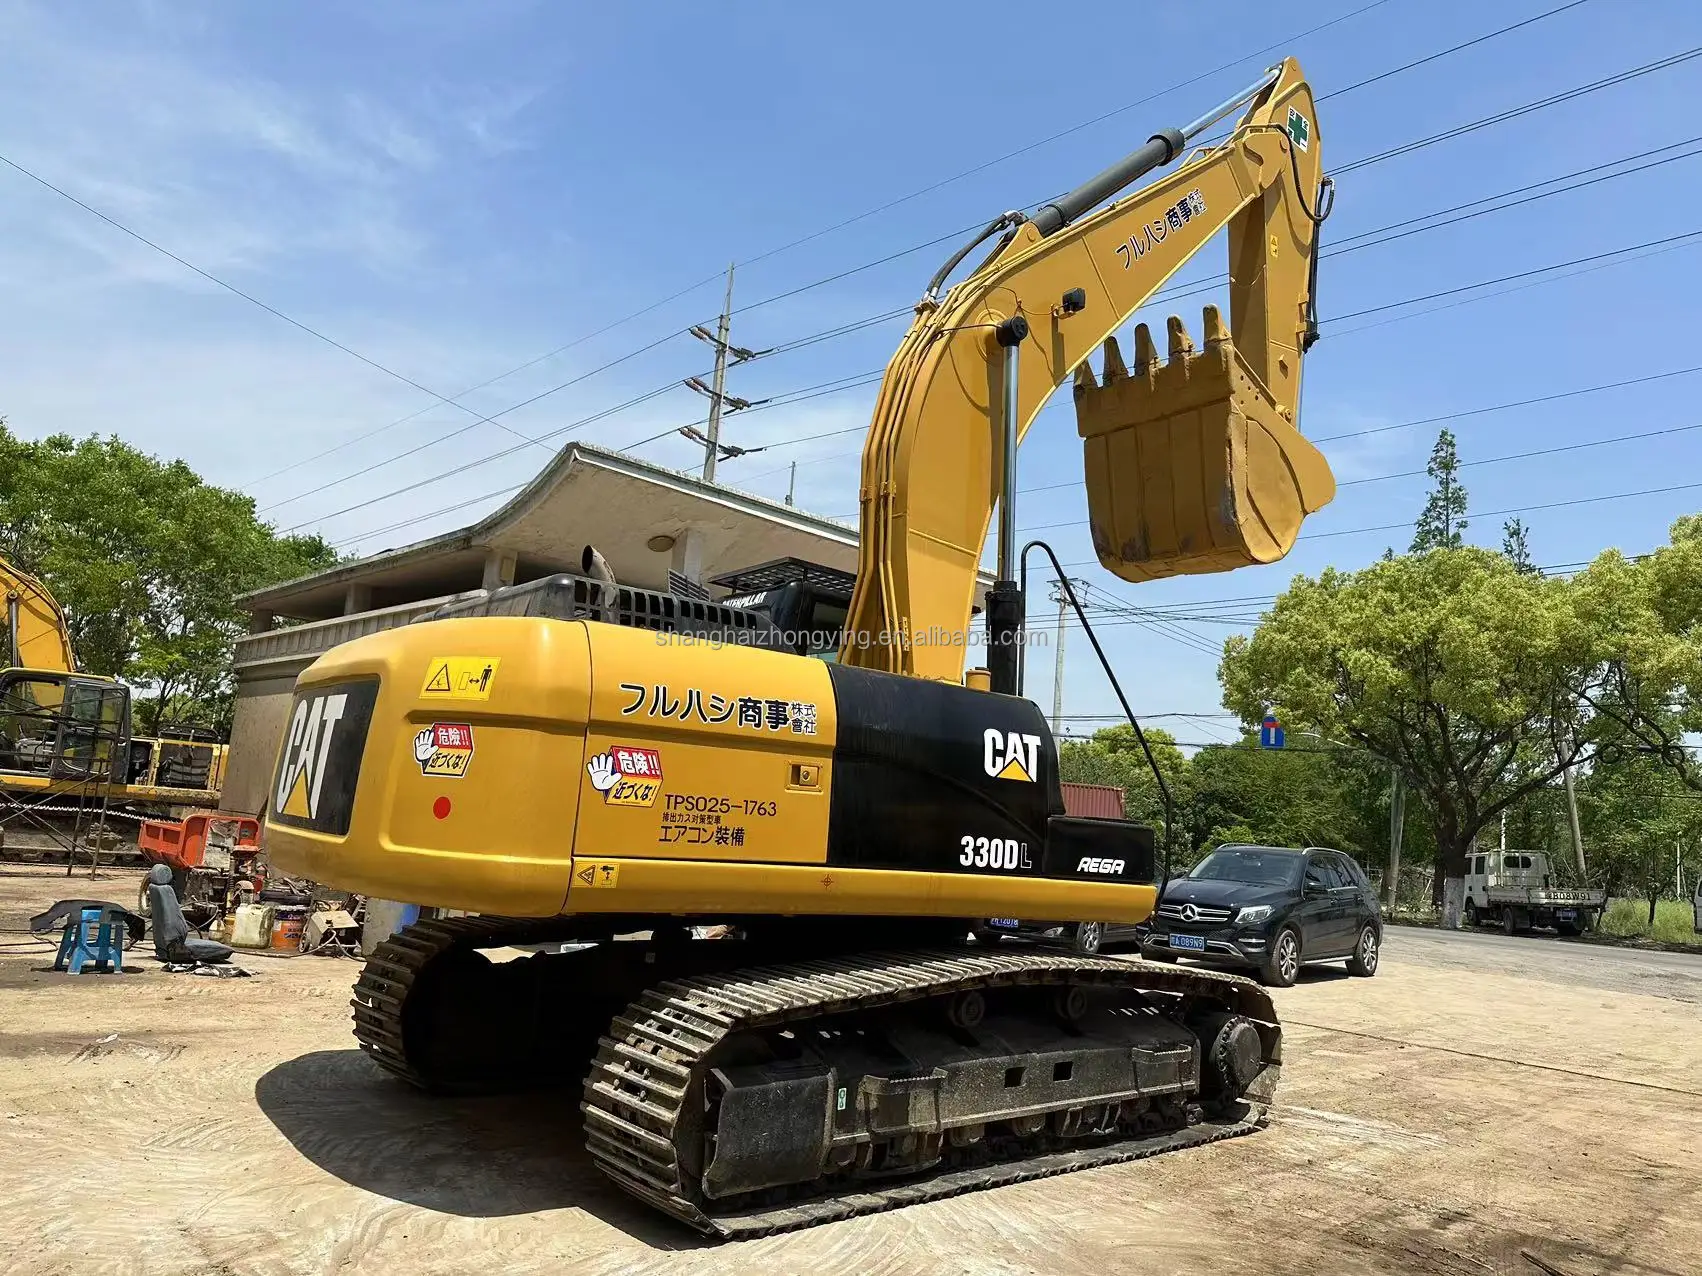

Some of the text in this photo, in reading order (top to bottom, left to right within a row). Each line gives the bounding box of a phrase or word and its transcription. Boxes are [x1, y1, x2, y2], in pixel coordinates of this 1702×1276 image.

[1115, 196, 1192, 270] フルハシ商事
[620, 683, 790, 730] フルハシ商事
[790, 701, 817, 718] 株式
[276, 694, 348, 820] CAT
[983, 728, 1042, 783] CAT
